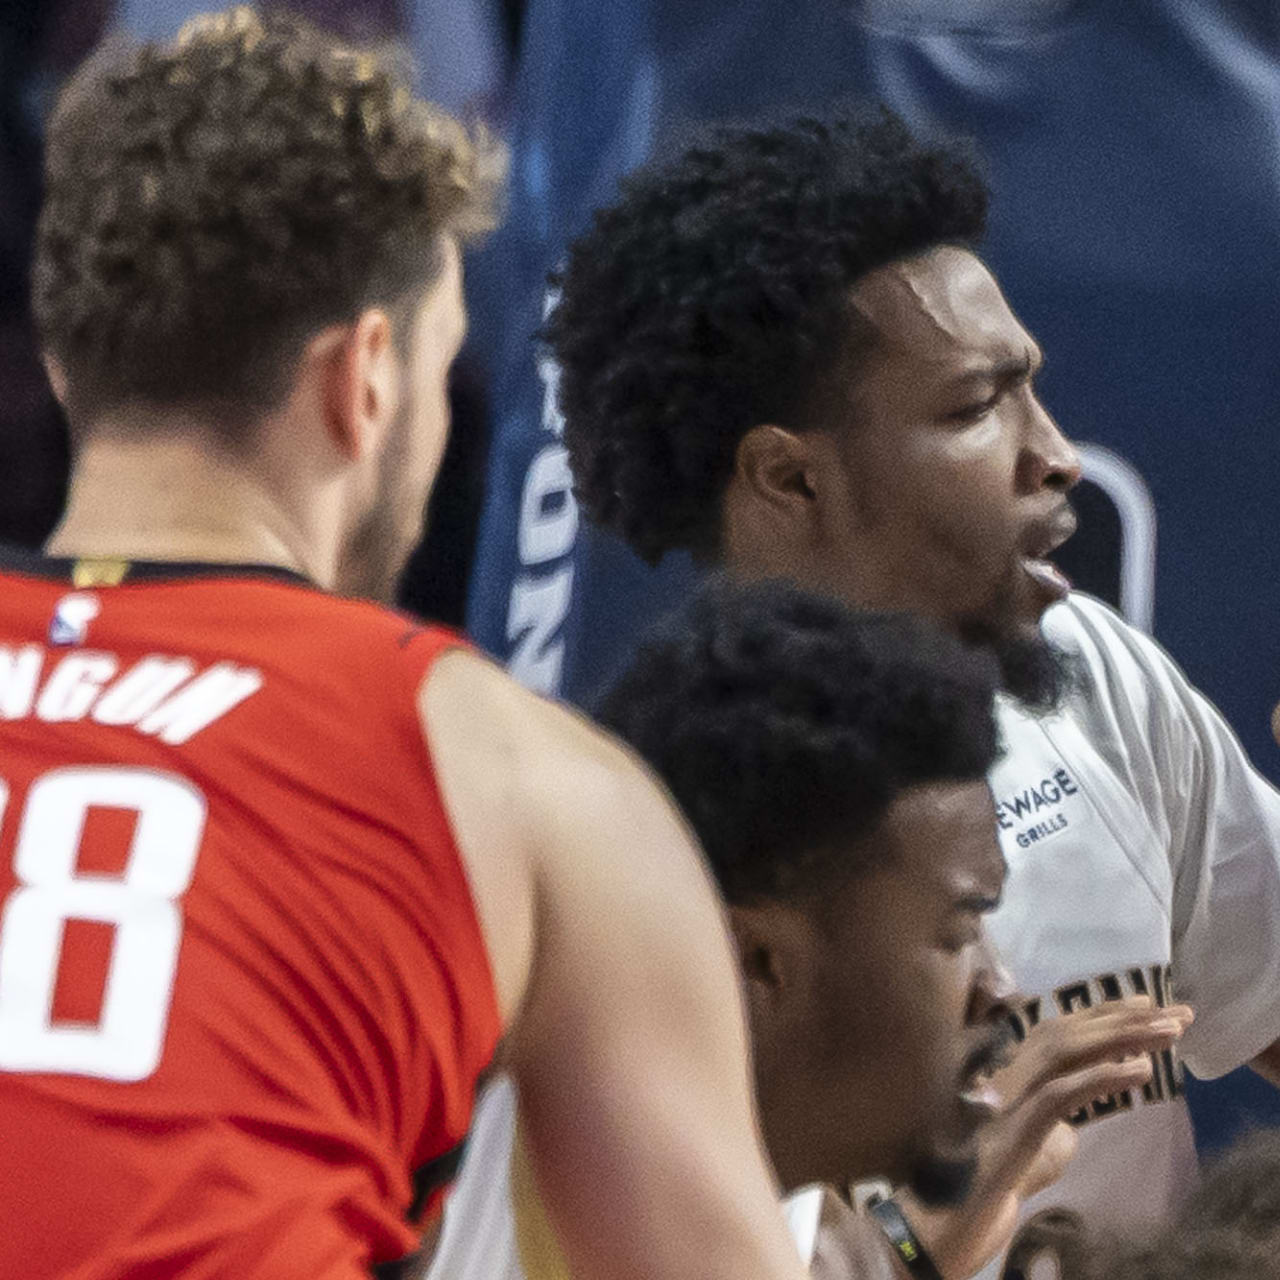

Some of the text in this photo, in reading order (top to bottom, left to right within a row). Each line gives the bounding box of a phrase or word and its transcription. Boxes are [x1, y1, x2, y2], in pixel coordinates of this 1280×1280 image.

[507, 352, 579, 697] ON
[0, 762, 208, 1084] 8
[1016, 813, 1069, 848] GRILLS
